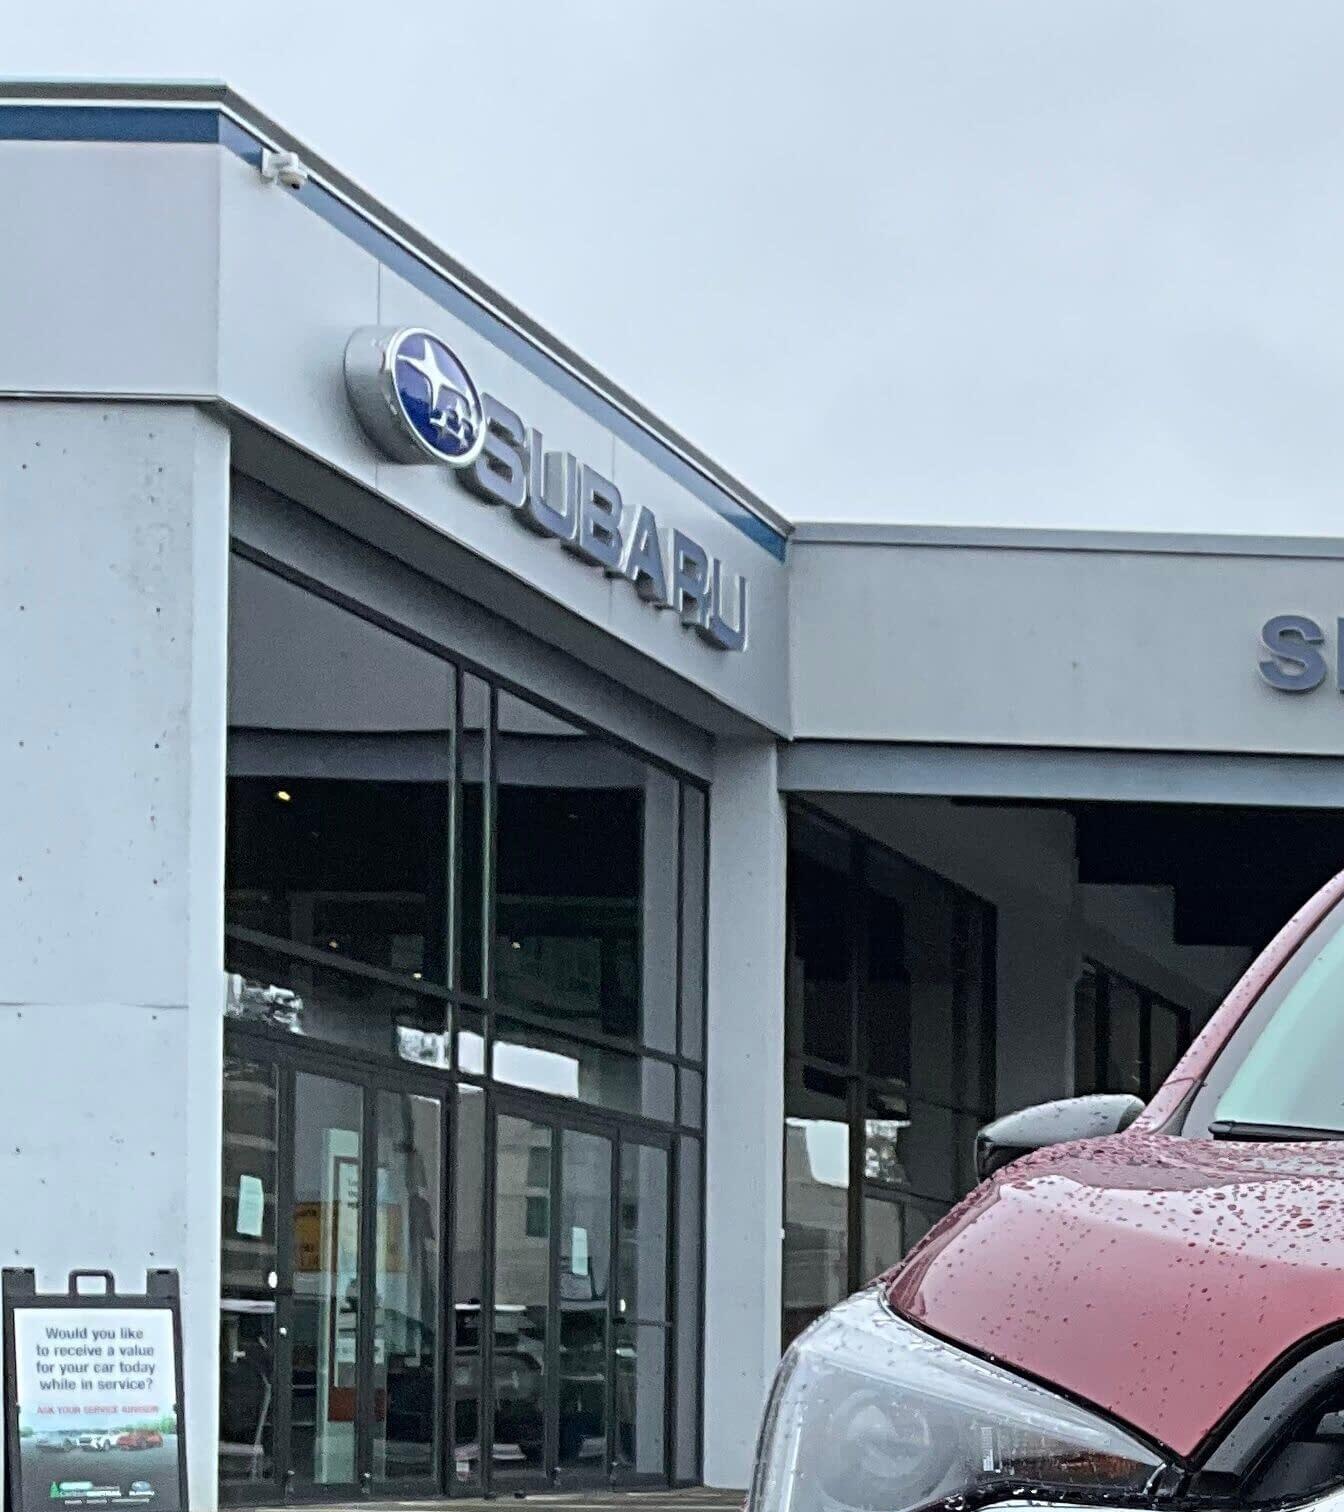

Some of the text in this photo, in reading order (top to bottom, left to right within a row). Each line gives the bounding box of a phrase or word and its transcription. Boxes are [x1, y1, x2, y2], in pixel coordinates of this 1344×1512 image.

[471, 391, 748, 653] SUBARU
[45, 1327, 144, 1341] Would you like
[36, 1344, 154, 1356] to receive a value
[36, 1361, 155, 1376] for your car today
[40, 1378, 153, 1390] while in service?
